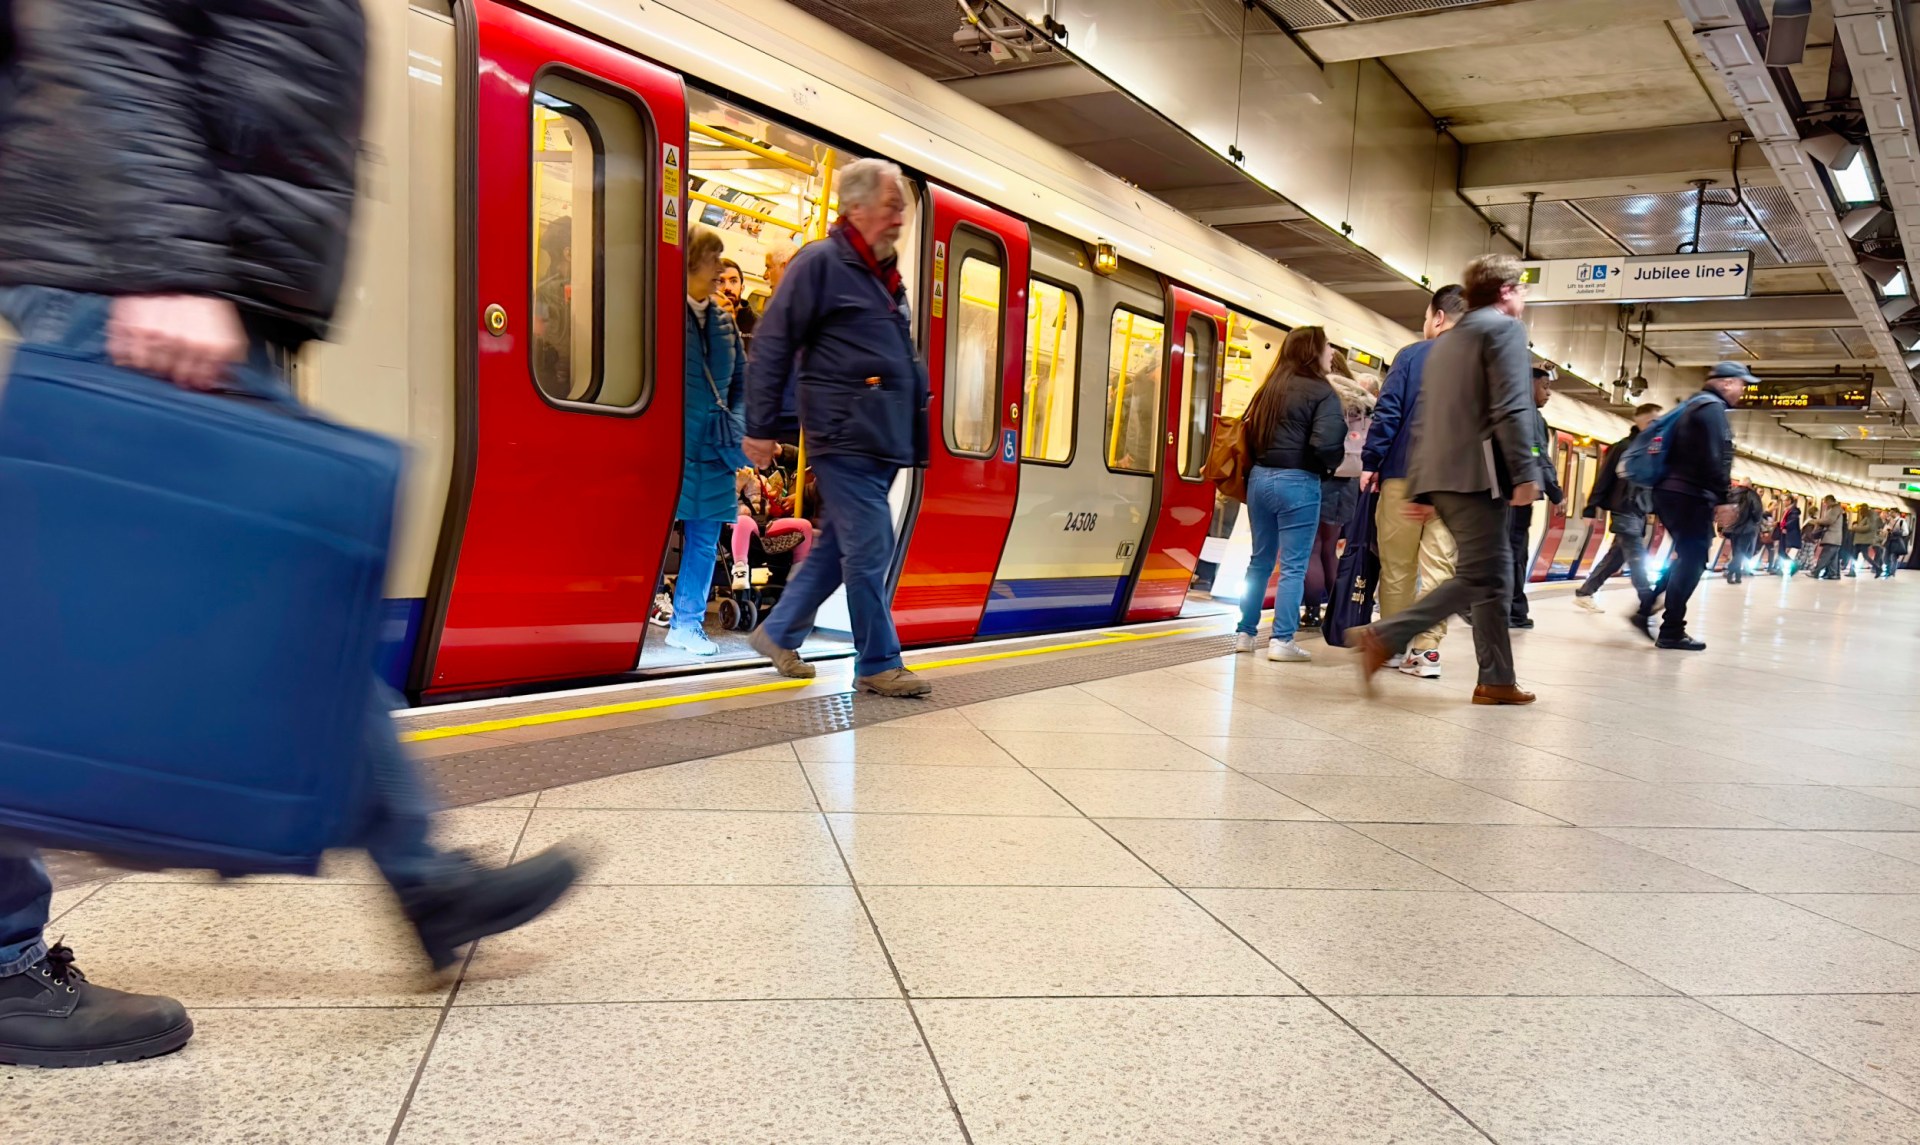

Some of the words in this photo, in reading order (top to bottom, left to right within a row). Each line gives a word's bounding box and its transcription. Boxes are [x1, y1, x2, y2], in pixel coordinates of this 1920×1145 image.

[1634, 267, 1690, 280] Jubilee
[1696, 265, 1725, 278] line
[1063, 512, 1098, 532] 24308
